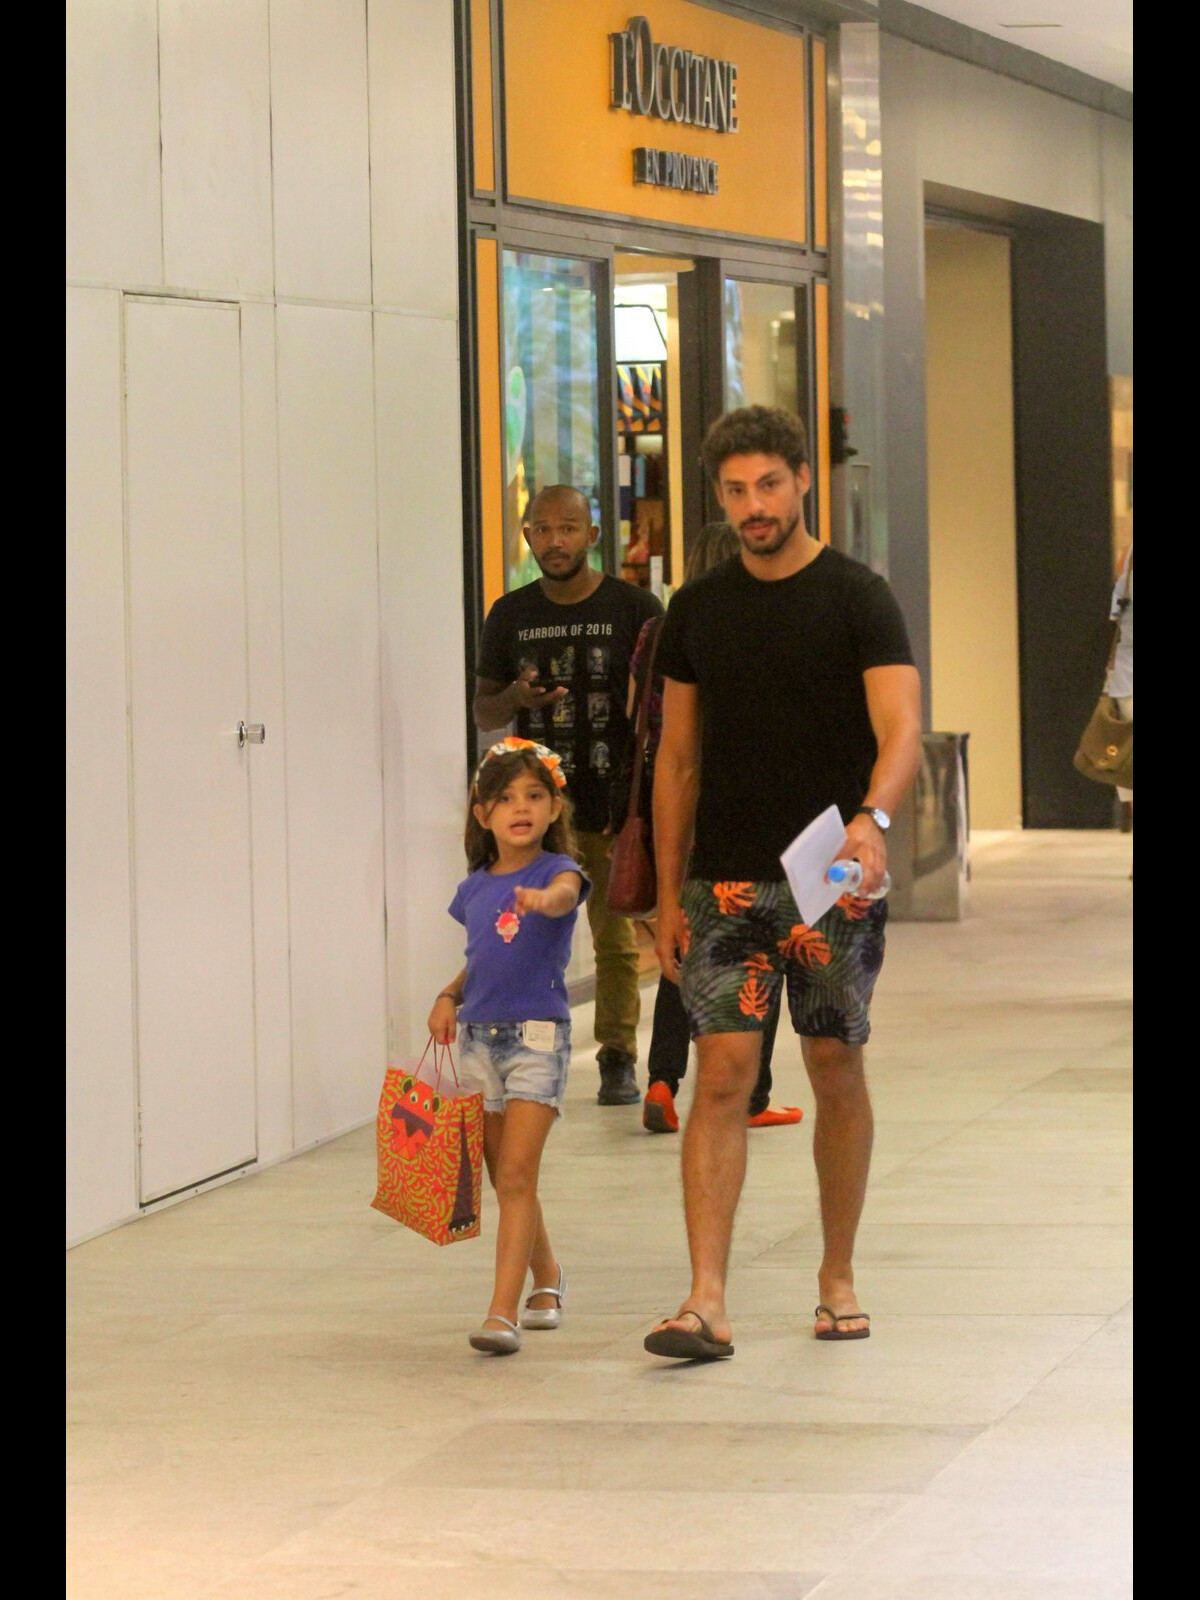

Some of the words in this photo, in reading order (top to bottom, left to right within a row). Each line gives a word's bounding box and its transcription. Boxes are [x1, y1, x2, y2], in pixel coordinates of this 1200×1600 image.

[612, 16, 739, 133] L'OCCITANE
[641, 148, 661, 184] EN
[664, 151, 718, 195] PROVENCE
[518, 624, 568, 641] YEARBOOK
[570, 624, 584, 637] OF
[586, 623, 613, 636] 2016
